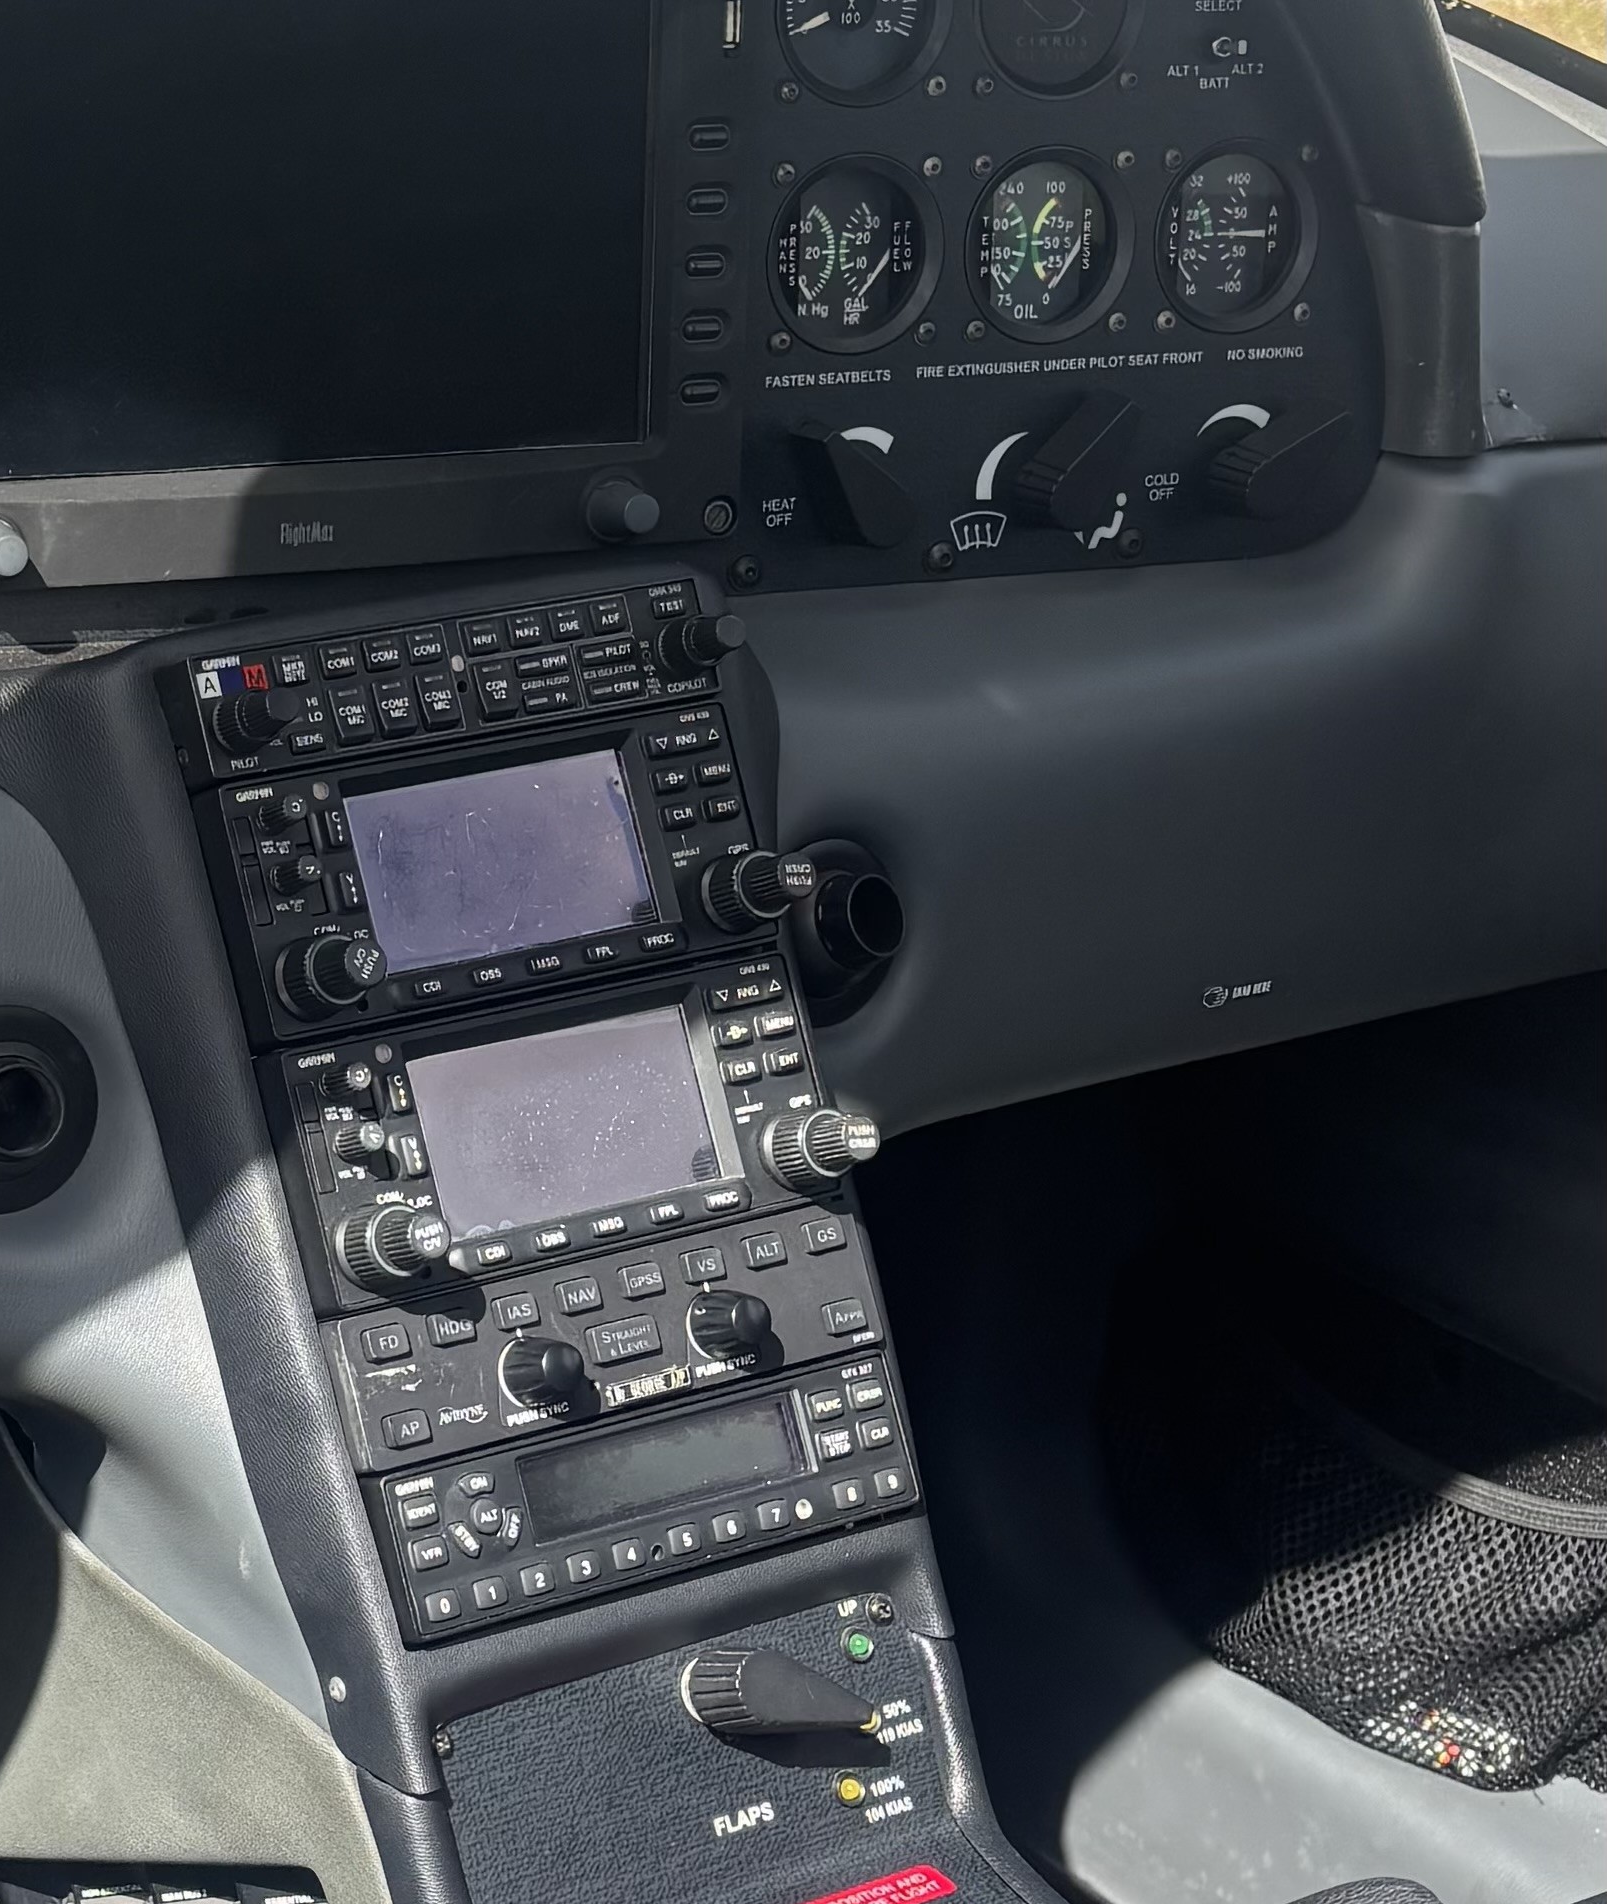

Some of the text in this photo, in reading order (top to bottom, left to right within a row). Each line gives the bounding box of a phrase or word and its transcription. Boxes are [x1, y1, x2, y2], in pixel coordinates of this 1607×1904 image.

[1195, 0, 1242, 12] SELECT
[841, 12, 861, 24] 100
[1199, 77, 1230, 90] BATT
[1014, 304, 1038, 319] OIL
[1248, 346, 1304, 360] SMOKING
[916, 350, 1203, 379] FIRE EXTINGUISHER UNDER PILOT SEAT FRONT
[765, 369, 891, 389] FASTEN SEATBELTS
[1144, 472, 1179, 487] COLD
[762, 497, 796, 513] HEAT
[766, 513, 792, 528] OFF
[756, 1240, 780, 1259] ALT
[507, 1302, 532, 1318] IAS
[400, 1422, 421, 1437] AP
[837, 1600, 858, 1617] UP
[882, 1699, 912, 1719] 50%
[870, 1775, 905, 1797] 100%
[713, 1802, 775, 1837] FLAPS
